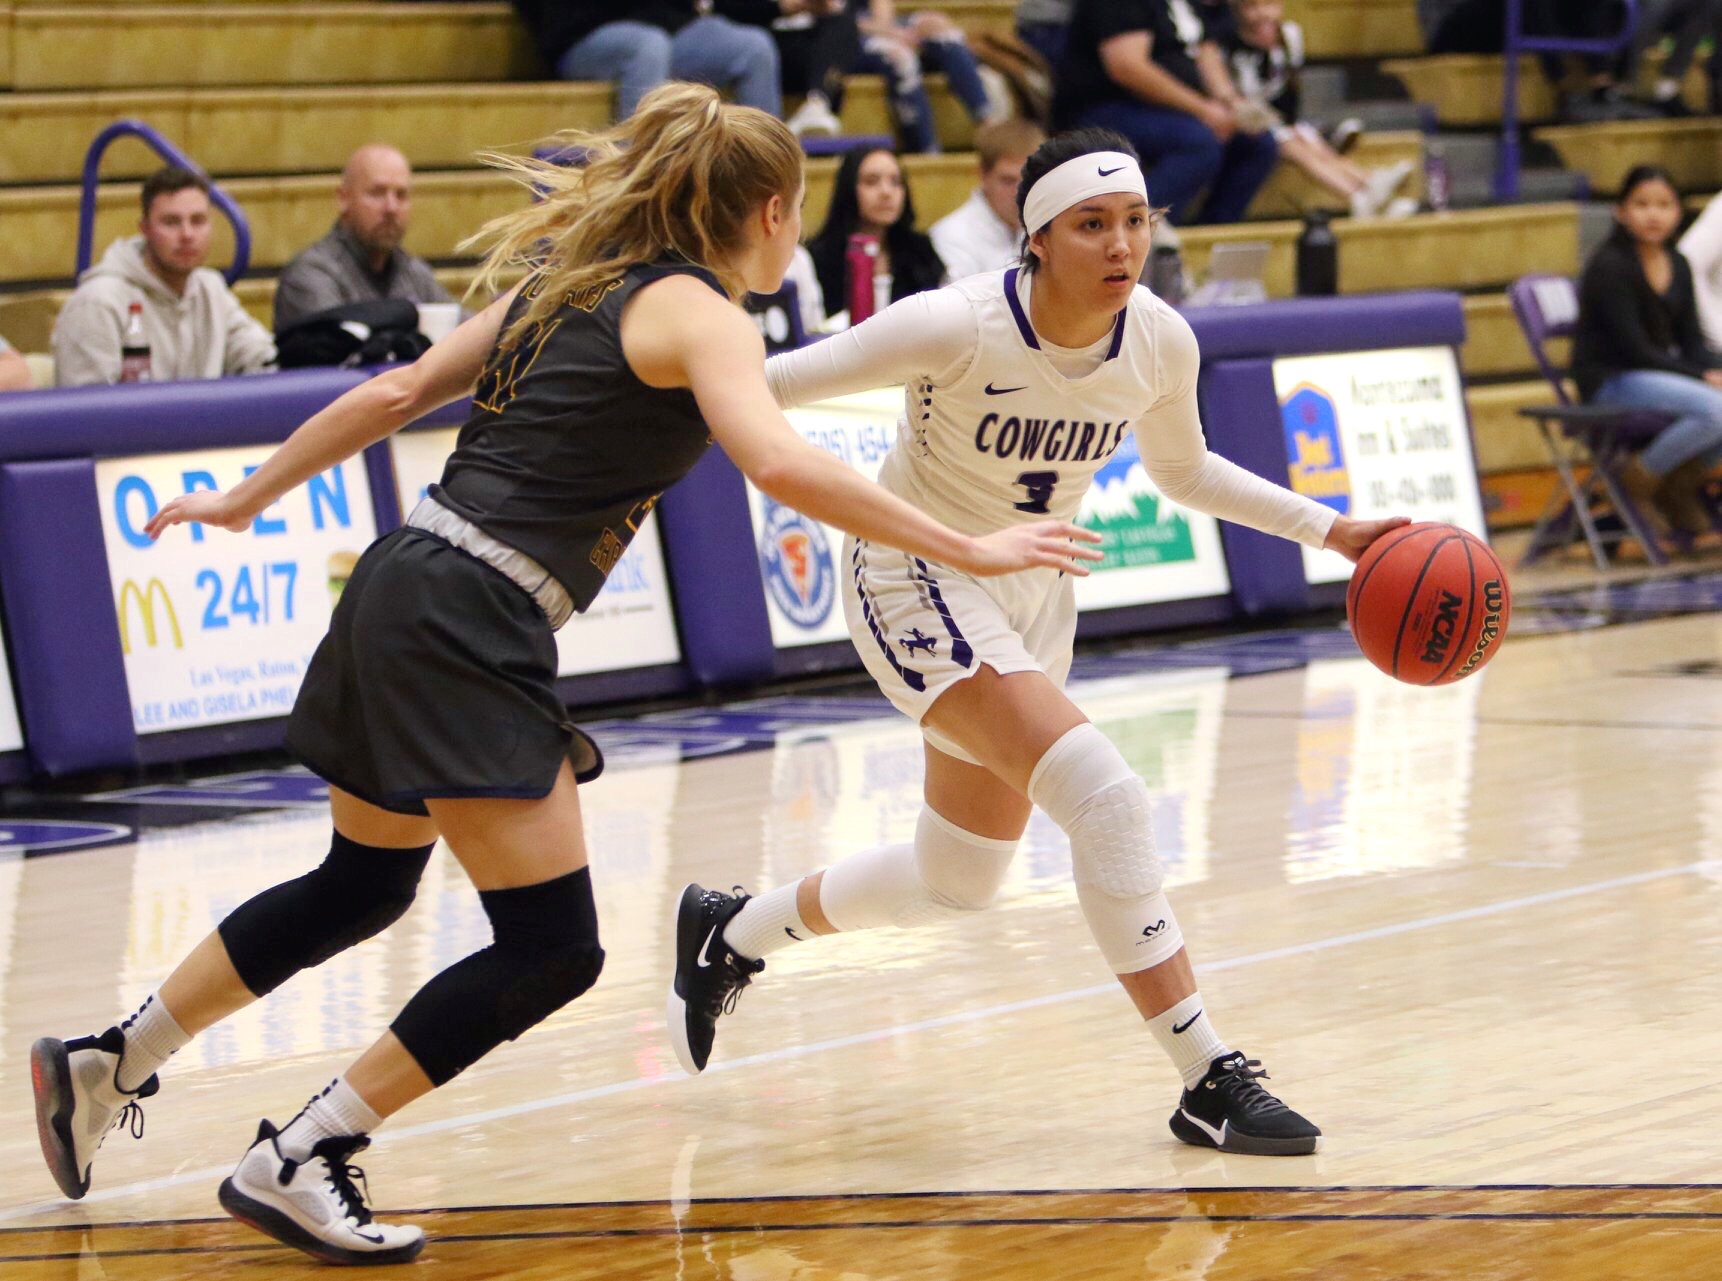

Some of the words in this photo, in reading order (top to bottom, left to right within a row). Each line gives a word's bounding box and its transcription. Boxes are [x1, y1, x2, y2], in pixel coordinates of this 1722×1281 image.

[975, 412, 1130, 462] COWGIRLS
[195, 562, 298, 630] 24/7
[1420, 589, 1463, 664] NCAA
[1454, 579, 1503, 678] Wilson
[167, 699, 199, 721] AND
[203, 691, 257, 717] GISELA
